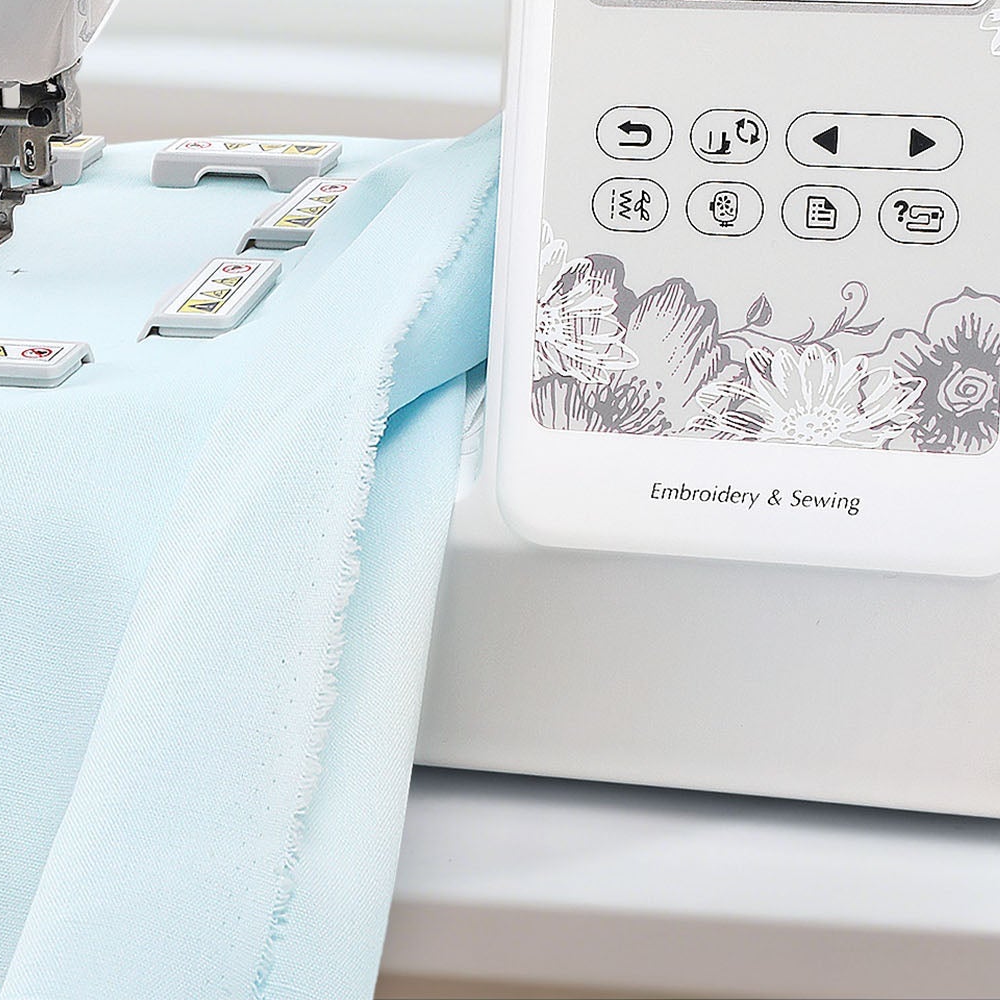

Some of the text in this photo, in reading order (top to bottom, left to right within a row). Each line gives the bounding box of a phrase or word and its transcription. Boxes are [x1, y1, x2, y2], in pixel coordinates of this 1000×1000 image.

[650, 482, 861, 516] Embroidery & Sewing
